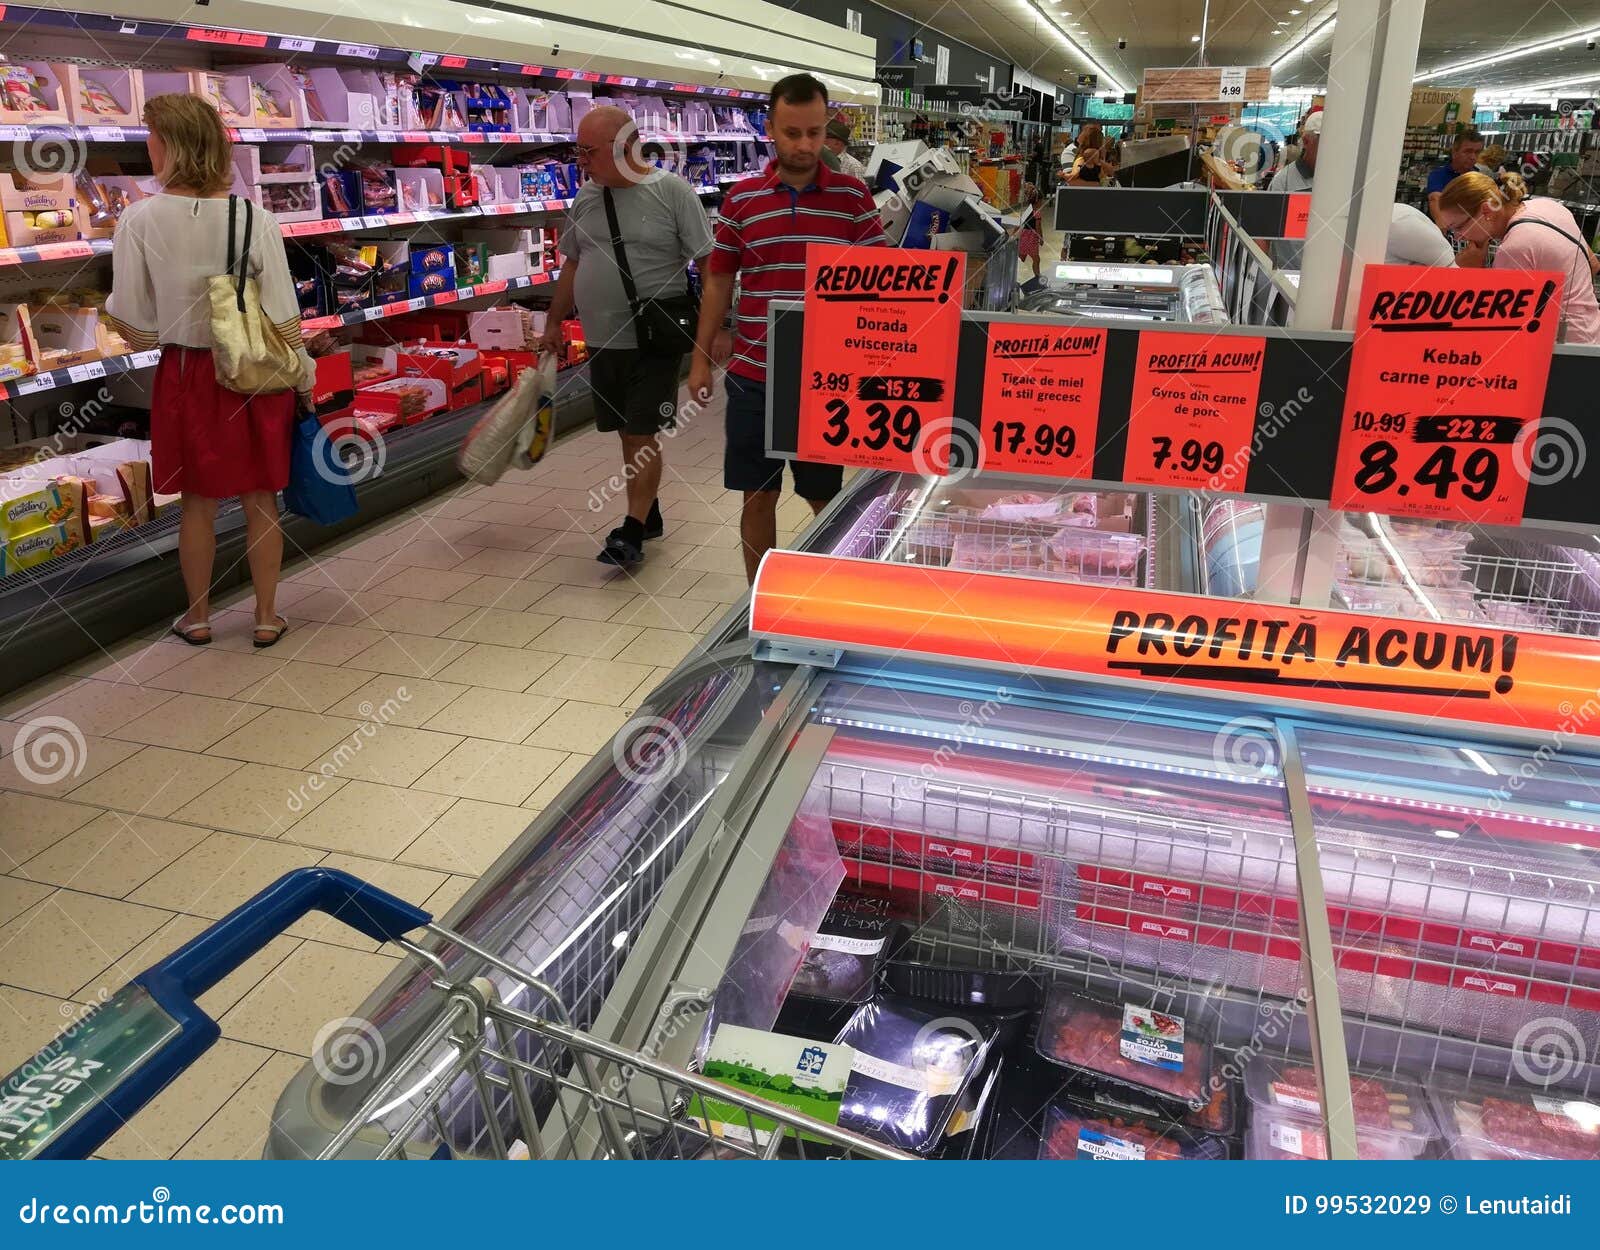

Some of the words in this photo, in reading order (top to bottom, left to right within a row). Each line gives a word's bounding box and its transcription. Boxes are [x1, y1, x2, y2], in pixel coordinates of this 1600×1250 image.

[1221, 86, 1241, 96] 4.99
[814, 257, 959, 304] REDUCERE!
[1369, 280, 1556, 333] REDUCERE!
[857, 316, 907, 333] Dorada
[844, 336, 917, 353] eviscerata
[1053, 334, 1101, 355] ACUM!
[1211, 350, 1262, 371] ACUM!
[1423, 348, 1481, 366] Kebab
[811, 371, 852, 392] 3.99
[877, 379, 904, 398] -15
[907, 380, 921, 399] %
[1002, 373, 1036, 386] Tigaie
[1040, 376, 1054, 386] de
[1058, 377, 1084, 388] miel
[1379, 371, 1429, 385] carne
[1436, 374, 1518, 390] porc-vita
[1001, 388, 1012, 398] in
[1016, 389, 1033, 400] stil
[1037, 392, 1081, 403] grecesc
[1152, 387, 1185, 401] Gyros
[1190, 390, 1209, 401] din
[1213, 394, 1247, 405] carne
[1174, 404, 1188, 414] de
[1192, 407, 1220, 417] porc
[822, 399, 921, 453] 3.39
[1352, 411, 1407, 433] 10.99
[1437, 418, 1474, 439] -22
[1479, 421, 1497, 441] %
[992, 420, 1076, 459] 17.99
[1152, 436, 1224, 474] 7.99
[1354, 440, 1499, 502] 8.49
[1335, 625, 1519, 695] ACUM!
